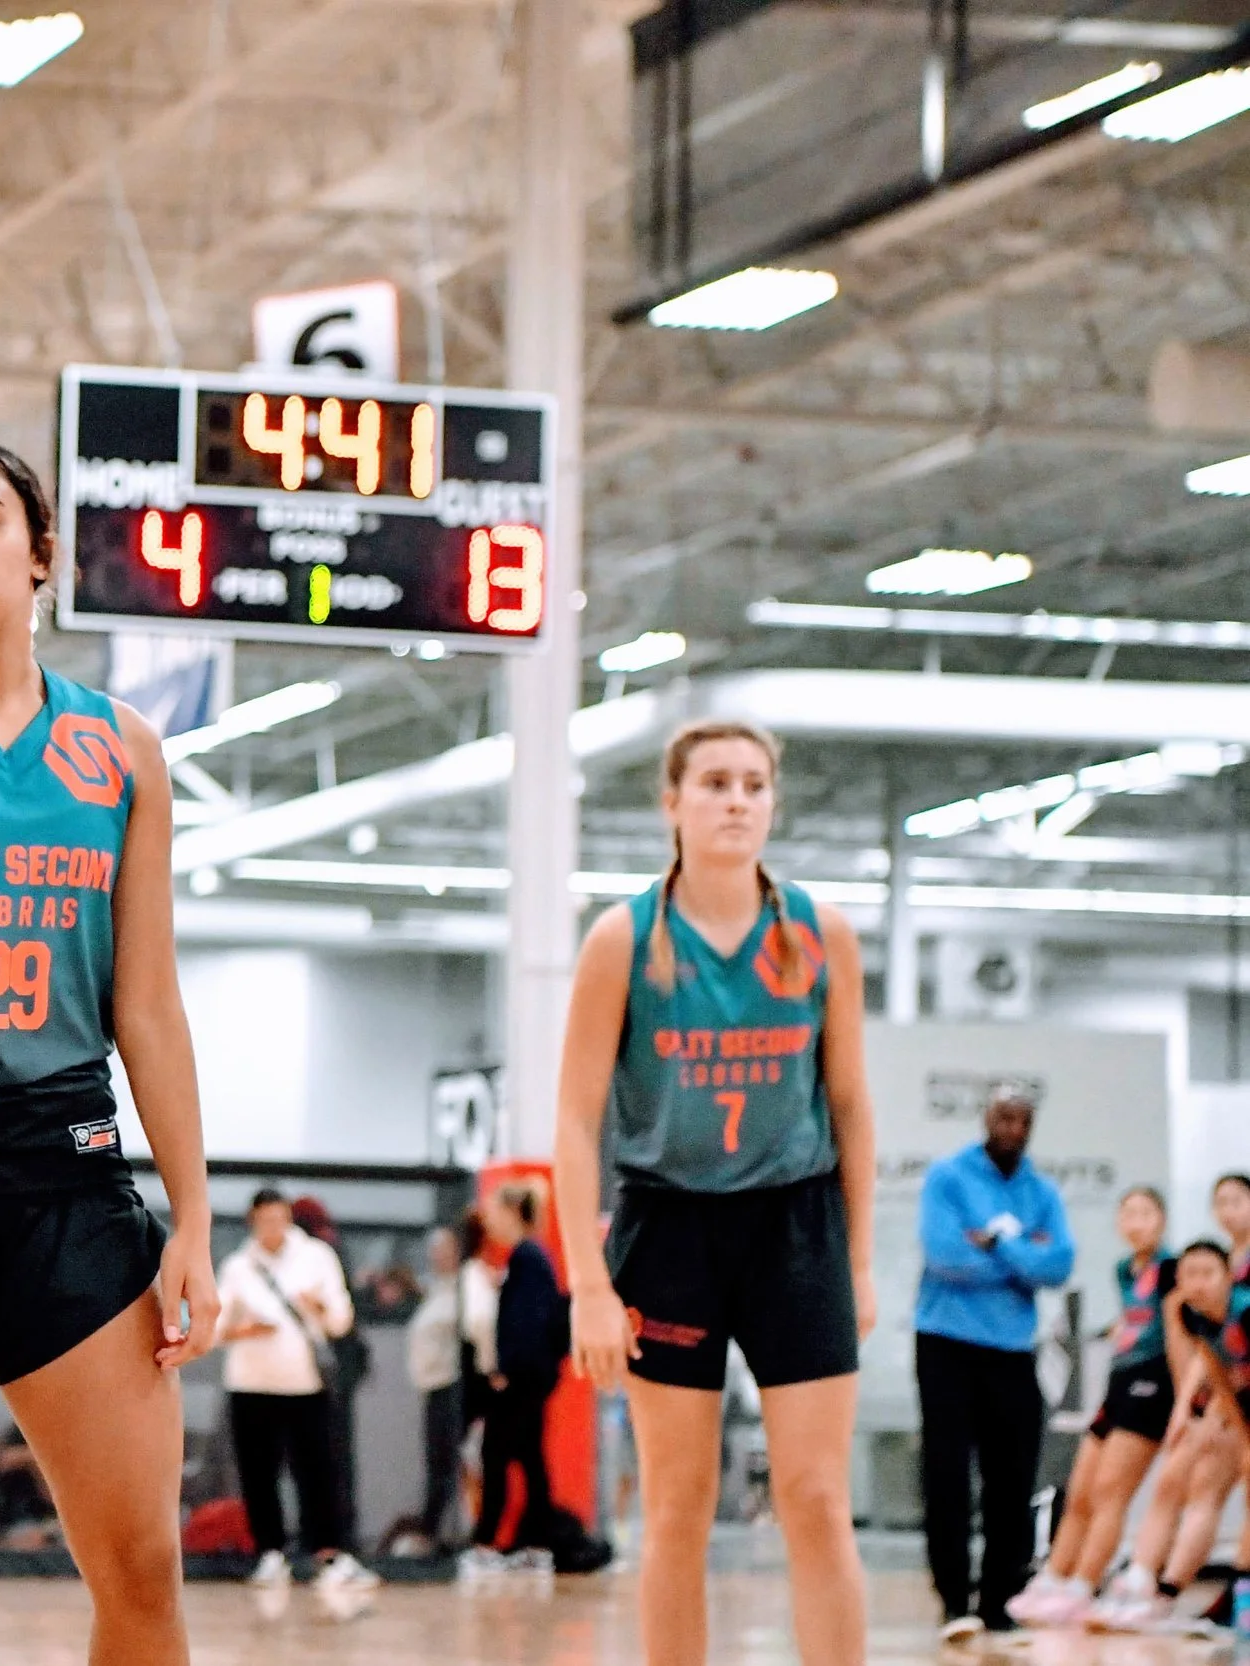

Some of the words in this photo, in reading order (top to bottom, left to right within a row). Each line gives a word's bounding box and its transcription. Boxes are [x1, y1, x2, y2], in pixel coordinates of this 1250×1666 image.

[76, 457, 187, 510] HOME
[141, 510, 203, 607] 4
[467, 524, 543, 631] 13
[309, 564, 331, 624] 1
[714, 1091, 747, 1153] 7
